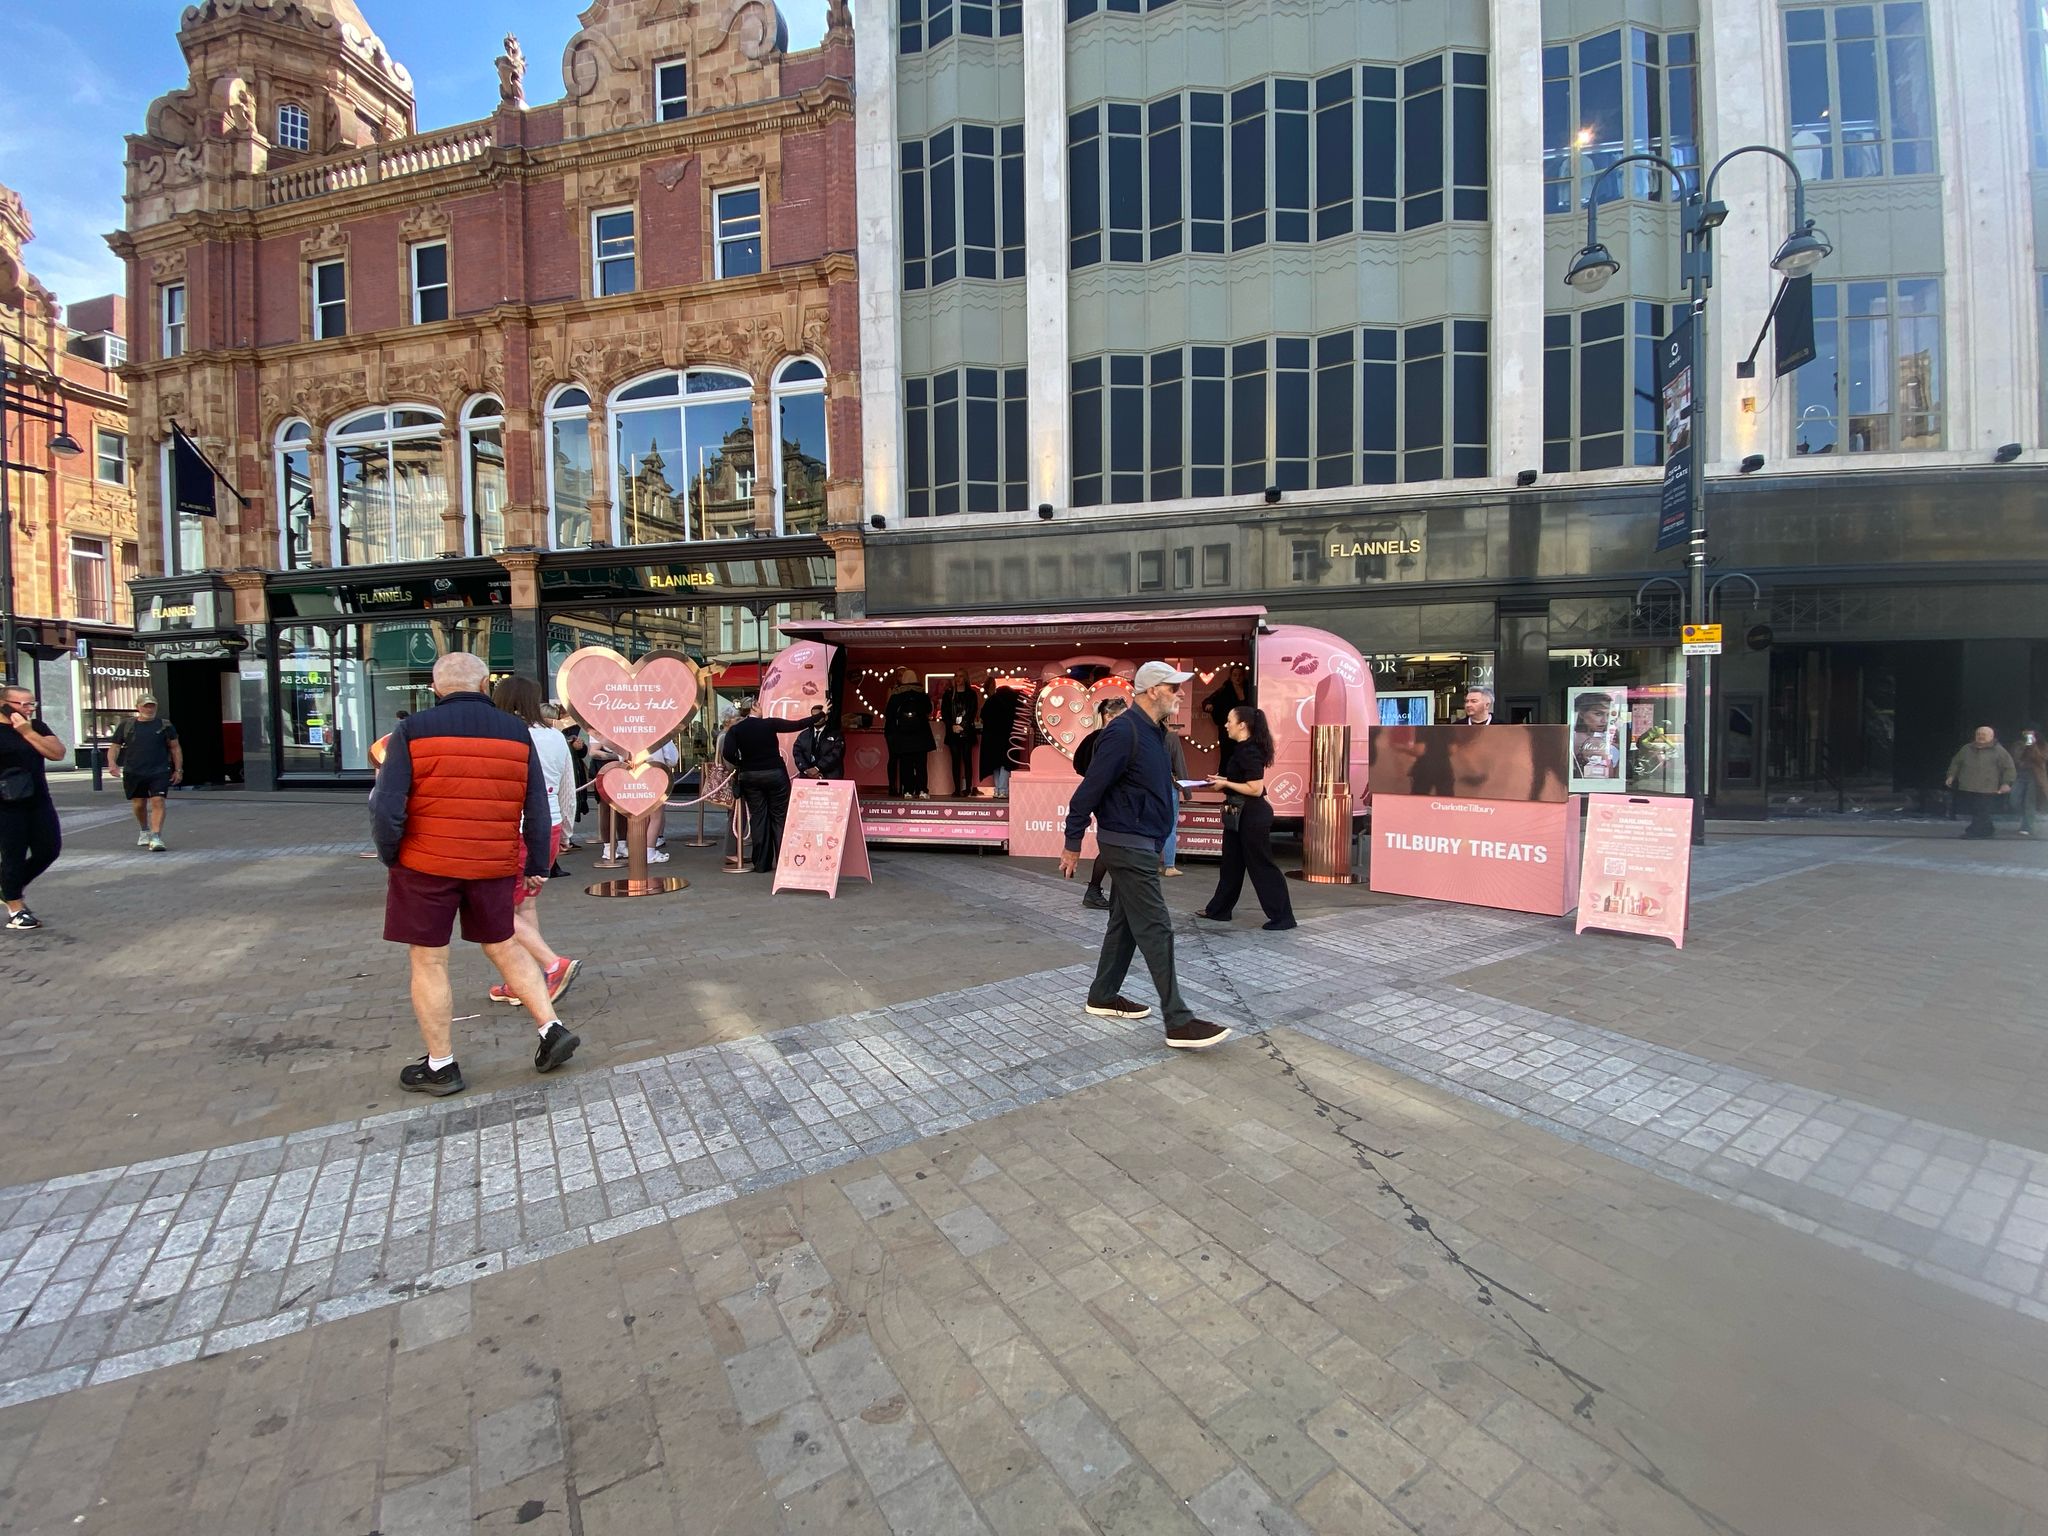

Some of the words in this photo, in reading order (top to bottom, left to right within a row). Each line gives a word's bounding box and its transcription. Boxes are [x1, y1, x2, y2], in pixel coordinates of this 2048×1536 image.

[1330, 540, 1420, 557] FLANNELS
[649, 573, 715, 588] FLANNELS
[359, 591, 413, 604] FLANNELS
[151, 605, 197, 619] FLANNELS
[839, 629, 898, 638] DARLINGS,
[902, 629, 922, 637] ALL
[926, 628, 948, 637] YOU
[952, 628, 981, 636] NEED
[985, 627, 997, 636] IS
[1000, 626, 1031, 636] LOVE
[1034, 626, 1059, 634] AND
[1340, 660, 1357, 674] LOVE
[1573, 654, 1621, 667] DIOR
[605, 684, 661, 692] CHARLOTTE'S
[588, 693, 640, 711] Pillow
[644, 698, 678, 710] talk
[624, 715, 645, 723] LOVE
[613, 726, 657, 734] UNIVERSE!
[624, 783, 649, 791] LEEDS,
[1274, 779, 1290, 794] KISS
[1280, 785, 1297, 801] TALK!
[617, 792, 656, 800] DARLINGS!
[1025, 821, 1053, 832] LOVE
[1057, 821, 1066, 832] IS
[1385, 832, 1462, 855] TILBURY
[1468, 840, 1548, 864] TREATS
